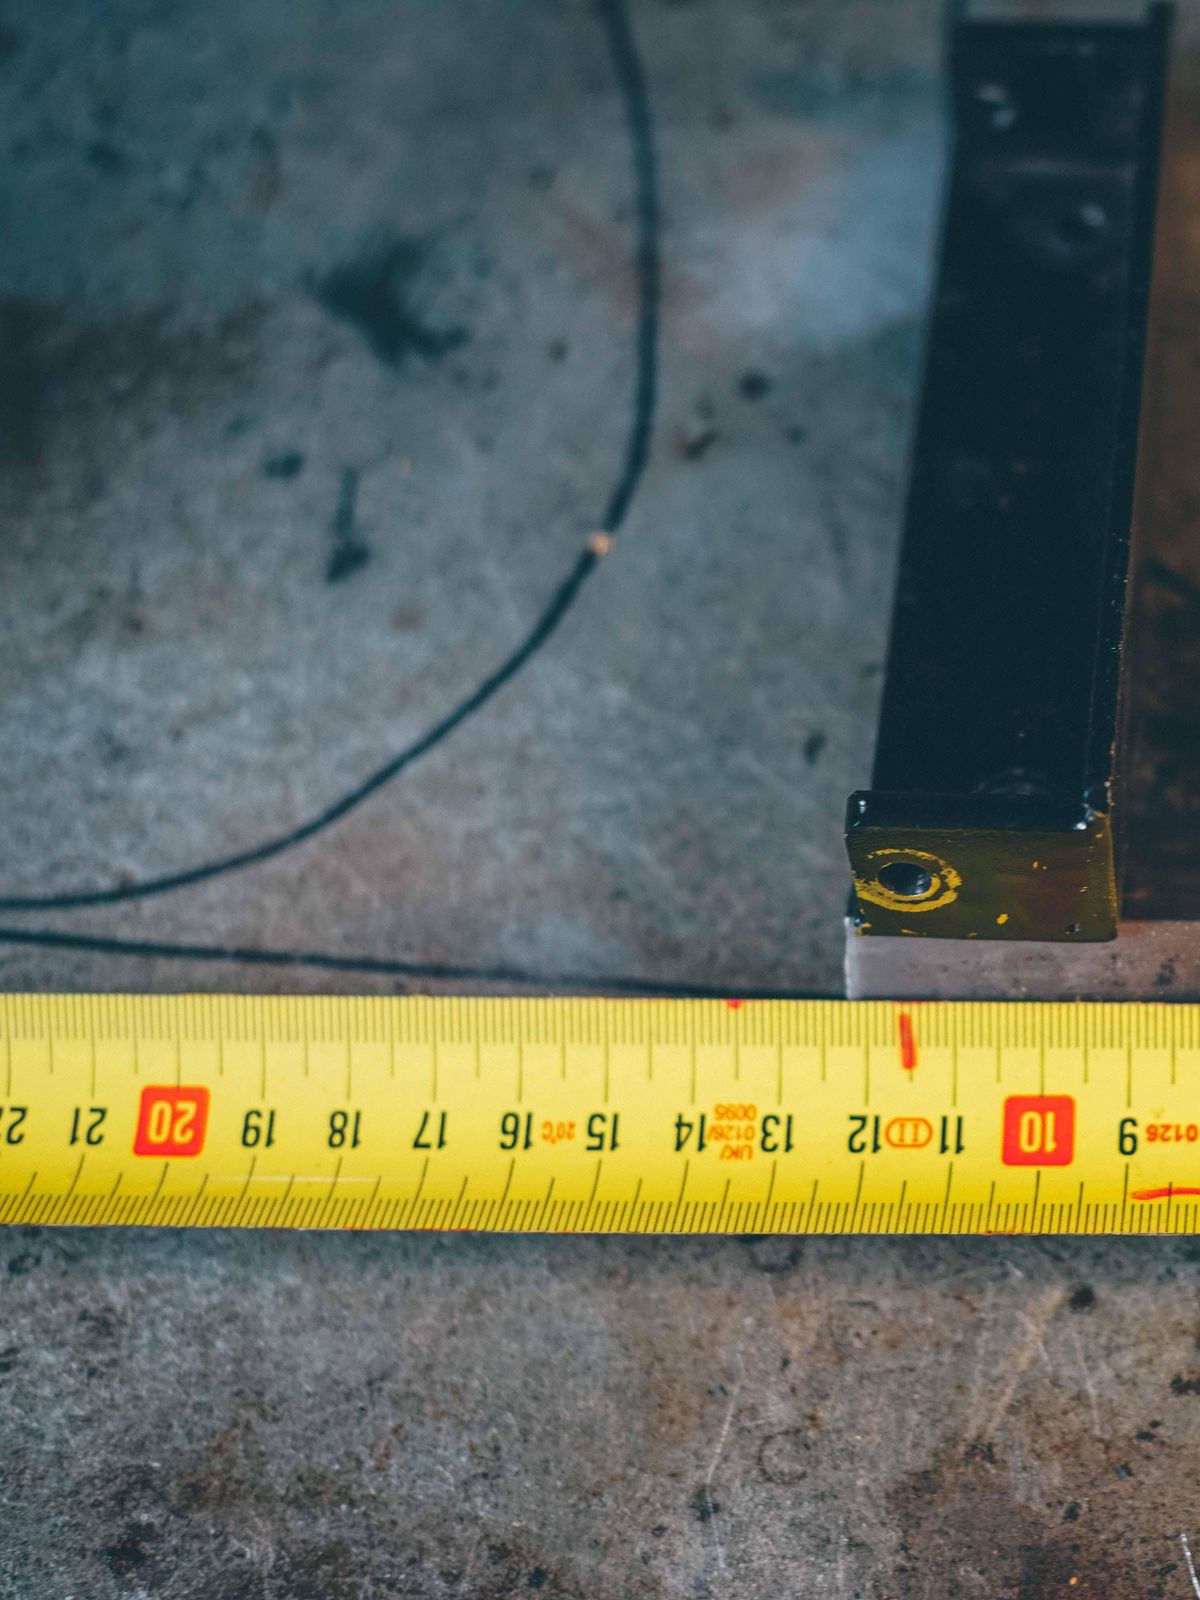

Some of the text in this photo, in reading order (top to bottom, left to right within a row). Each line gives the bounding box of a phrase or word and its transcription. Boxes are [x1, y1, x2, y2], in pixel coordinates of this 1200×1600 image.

[70, 1107, 107, 1146] 21
[148, 1100, 198, 1144] 20
[241, 1109, 276, 1148] 19
[328, 1110, 361, 1149] 18
[412, 1110, 447, 1149] 17
[500, 1112, 533, 1151] 16
[585, 1112, 619, 1152] 15
[674, 1113, 707, 1152] 14
[761, 1114, 794, 1153] 13
[848, 1114, 881, 1154] 12
[939, 1115, 965, 1155] 11
[1019, 1110, 1058, 1153] 10
[1118, 1117, 1139, 1156] 9
[1145, 1123, 1200, 1143] 0126
